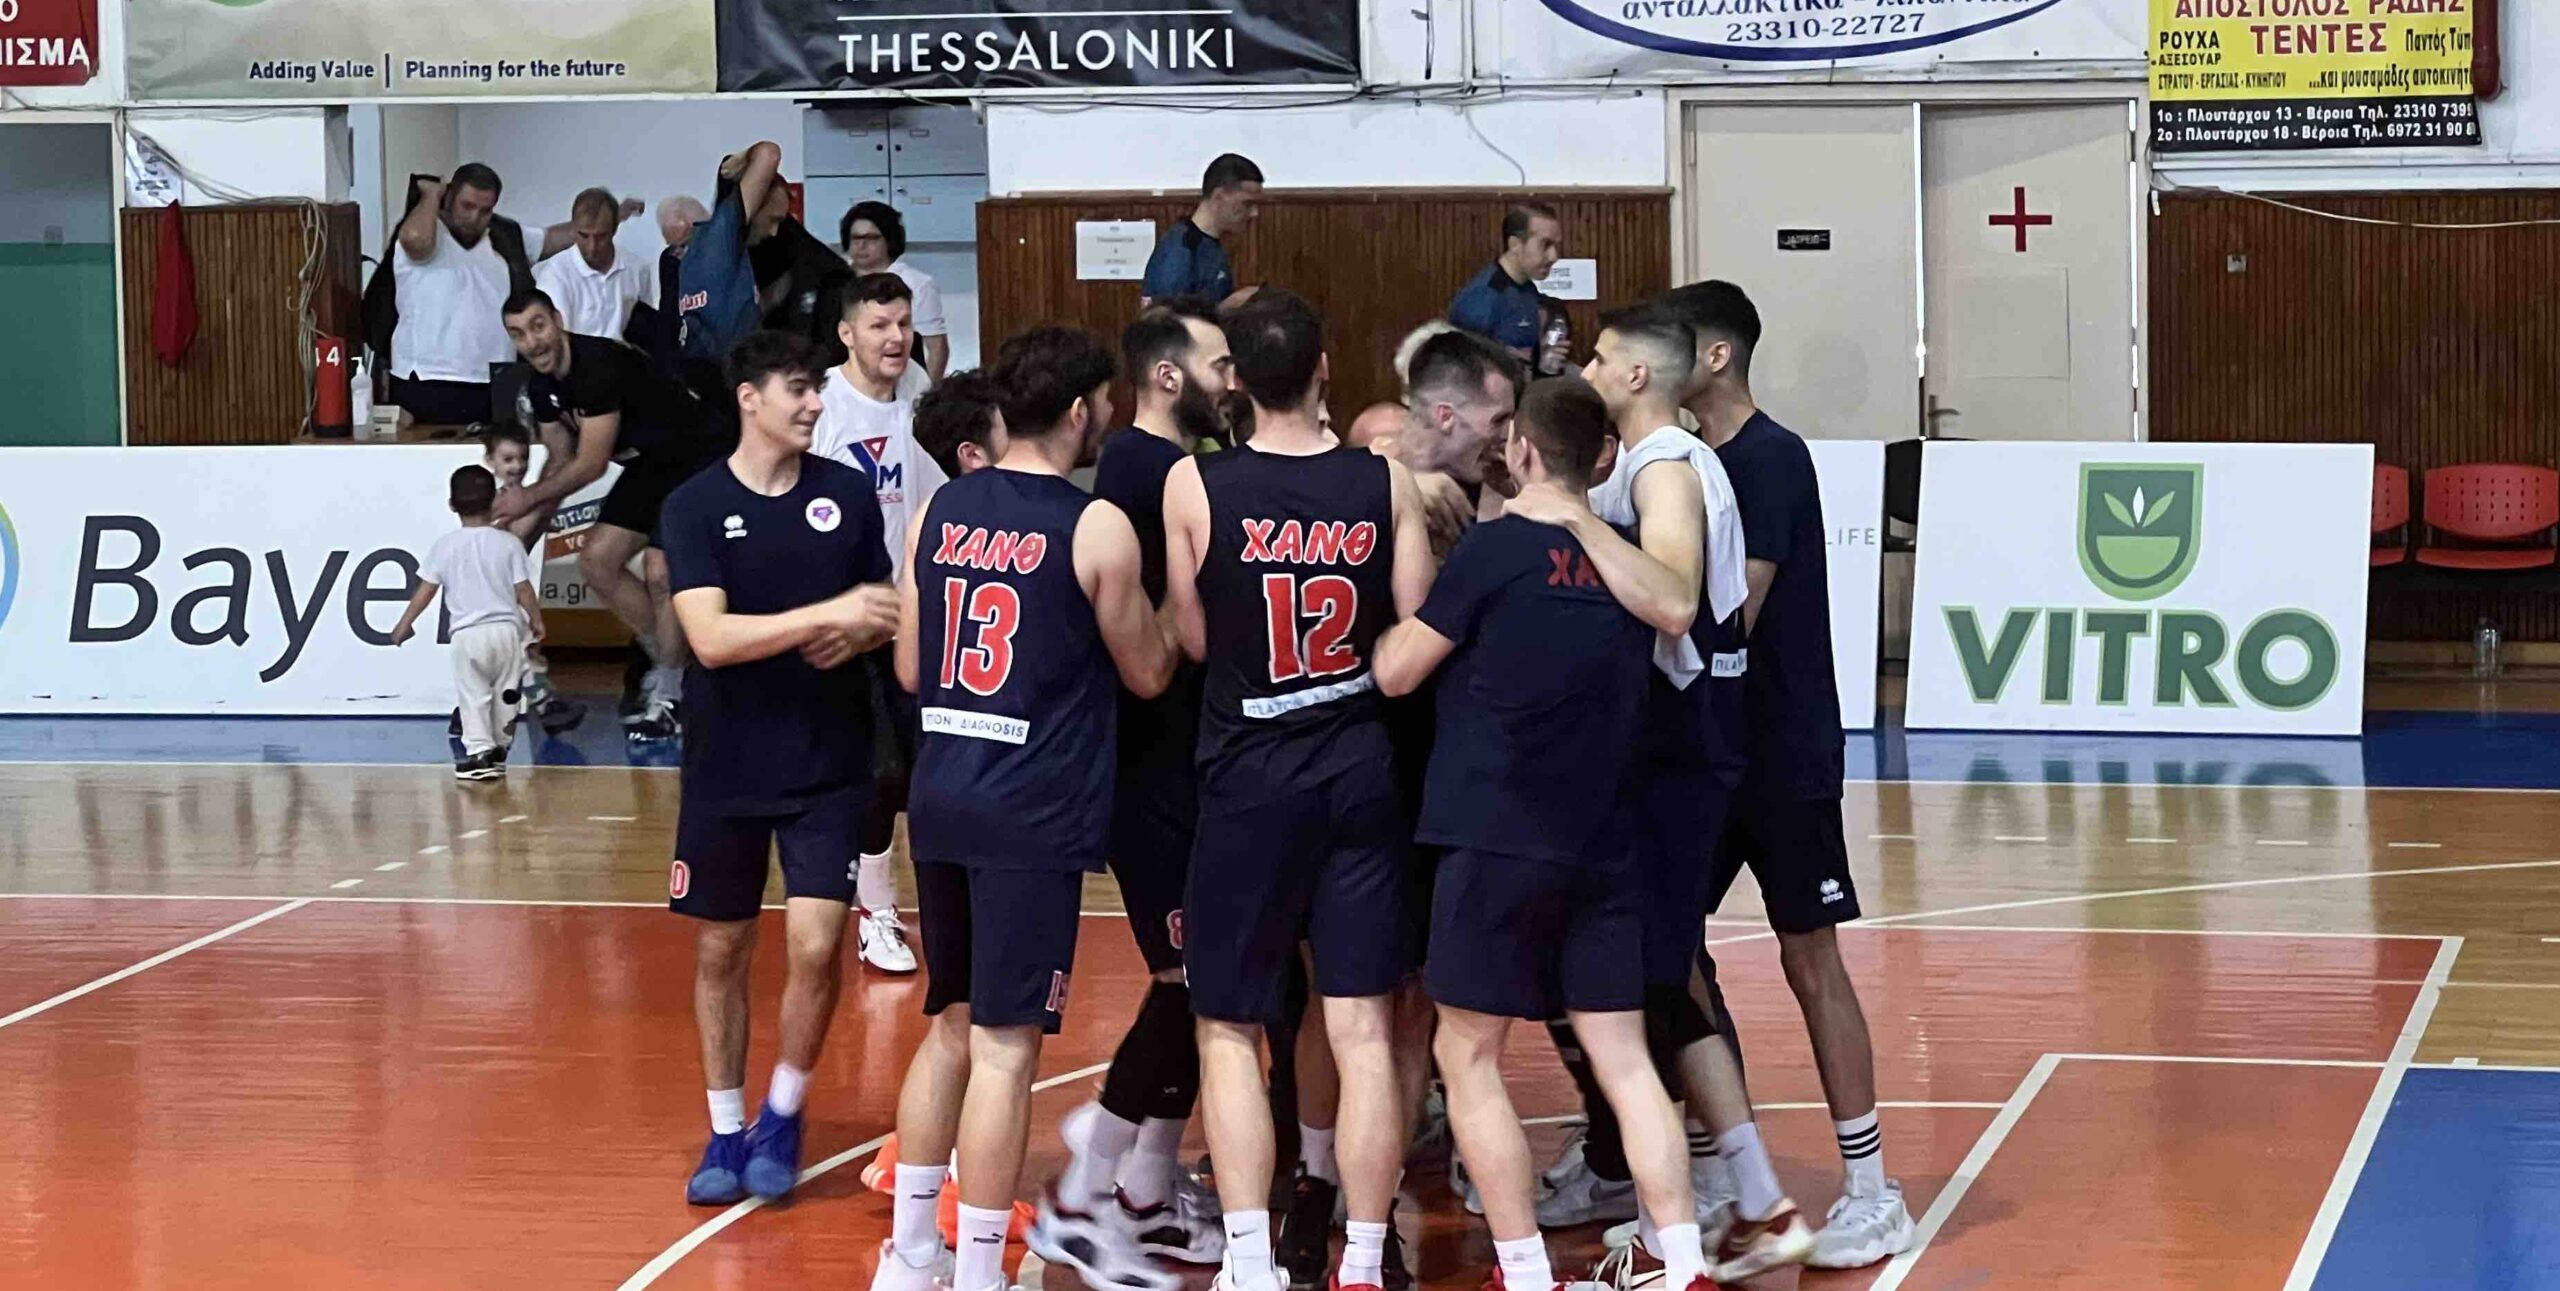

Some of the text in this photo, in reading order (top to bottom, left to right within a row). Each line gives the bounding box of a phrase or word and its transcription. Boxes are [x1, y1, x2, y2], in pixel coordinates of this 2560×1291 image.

[2175, 0, 2350, 18] ΑΠΟΣΤΟΛΟΣ
[1726, 13, 1925, 42] 23310-22727
[2160, 30, 2220, 50] ΡΟΥΧΑ
[2250, 22, 2388, 55] ΤΕΝΤΕΣ
[2405, 26, 2472, 56] Παντός Τύπ
[0, 37, 90, 69] ΙΣΜΑ
[838, 28, 1235, 73] THESSALONIKI
[2158, 53, 2222, 67] ΑΞΕΣΟΥΑΡ
[249, 59, 626, 83] Adding Value Planning for the future
[2158, 73, 2194, 90] ΣΤΡΑΤΟΥ
[2201, 73, 2239, 89] ΕΡΓΑΣΙΑΣ
[2341, 63, 2410, 94] μουσαμάδες
[2187, 107, 2271, 125] Πλουτάρχου
[2276, 106, 2293, 121] 13
[2306, 105, 2354, 123] Βέροια
[2359, 105, 2389, 122] Τηλ.
[2394, 103, 2437, 119] 23310
[2185, 126, 2269, 144] Πλουτάρχου
[2273, 125, 2290, 140] 18
[2302, 124, 2349, 142] Βέροια
[2353, 124, 2383, 141] Τηλ.
[2387, 123, 2422, 138] 6972
[2425, 122, 2442, 137] 31
[2446, 122, 2463, 137] 90
[933, 522, 1047, 575] ΧΑΝΘ
[1240, 518, 1377, 566] ΧΑΝΘ
[940, 576, 1021, 697] 13
[1263, 573, 1361, 684] 12
[1941, 605, 2341, 712] VITRO
